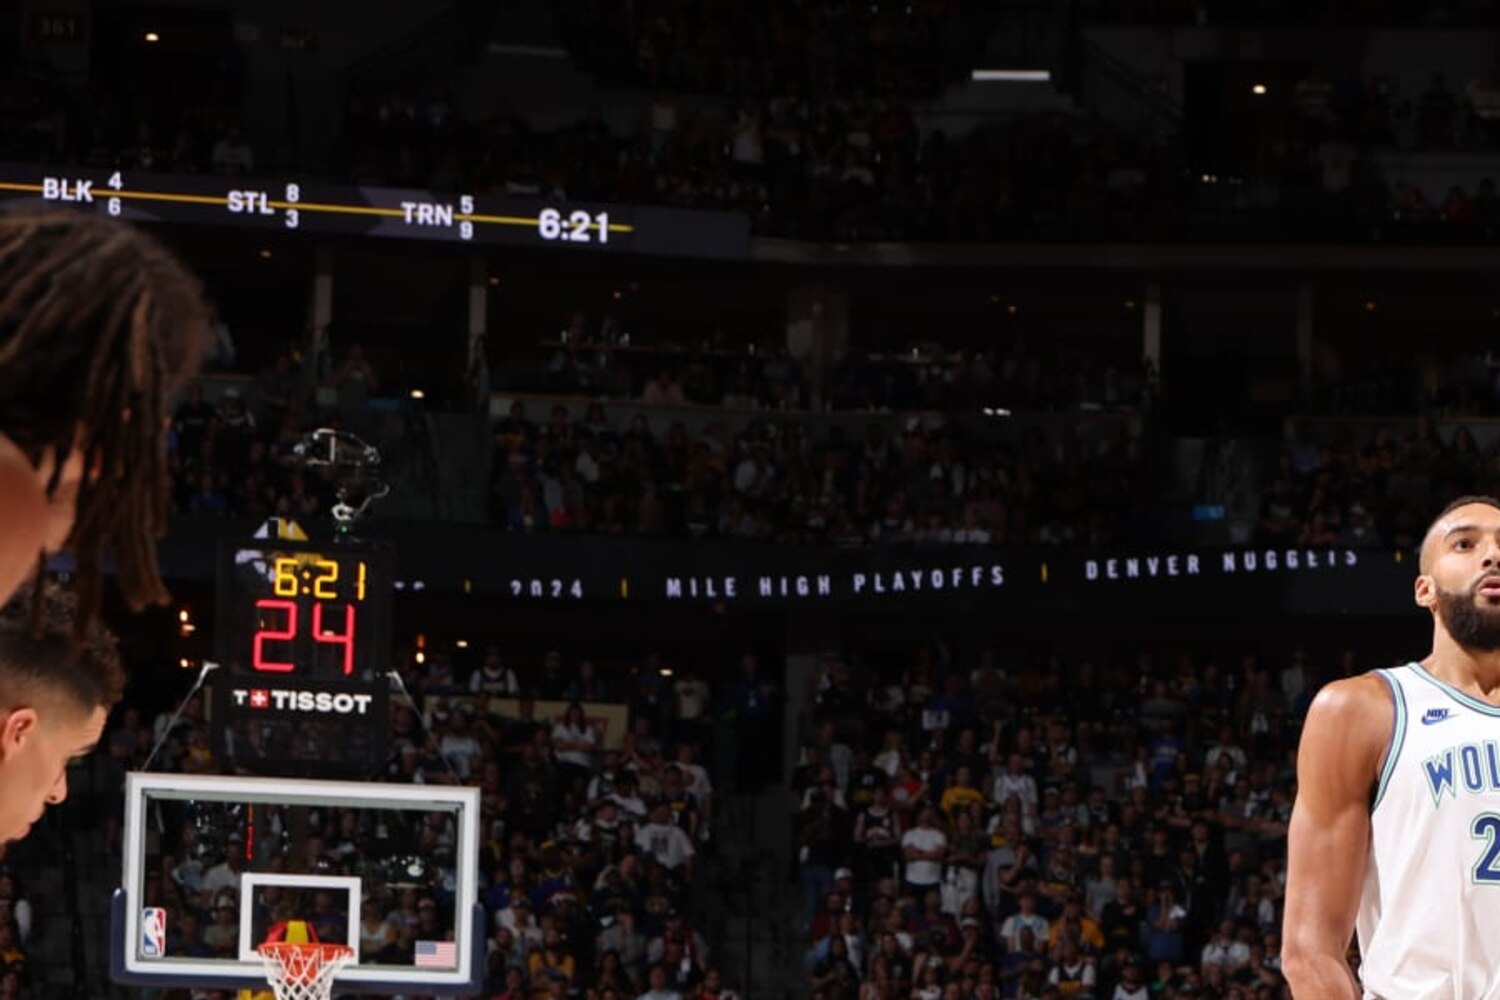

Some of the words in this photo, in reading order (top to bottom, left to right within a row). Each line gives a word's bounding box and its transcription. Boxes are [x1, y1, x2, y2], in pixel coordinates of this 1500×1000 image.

[42, 177, 93, 202] BLK
[108, 172, 123, 190] 4
[285, 183, 300, 202] 8
[108, 197, 122, 216] 6
[227, 190, 275, 215] STL
[401, 202, 453, 226] TRN
[459, 195, 474, 214] 5
[285, 209, 299, 228] 3
[459, 221, 474, 240] 9
[538, 208, 609, 243] 6:21
[275, 558, 366, 600] 6:21
[1085, 555, 1200, 580] DENVER
[665, 577, 737, 599] MILE
[759, 575, 832, 598] HIGH
[853, 565, 1004, 594] PLAYOFFS
[253, 600, 356, 676] 24
[271, 690, 373, 715] TISSOT
